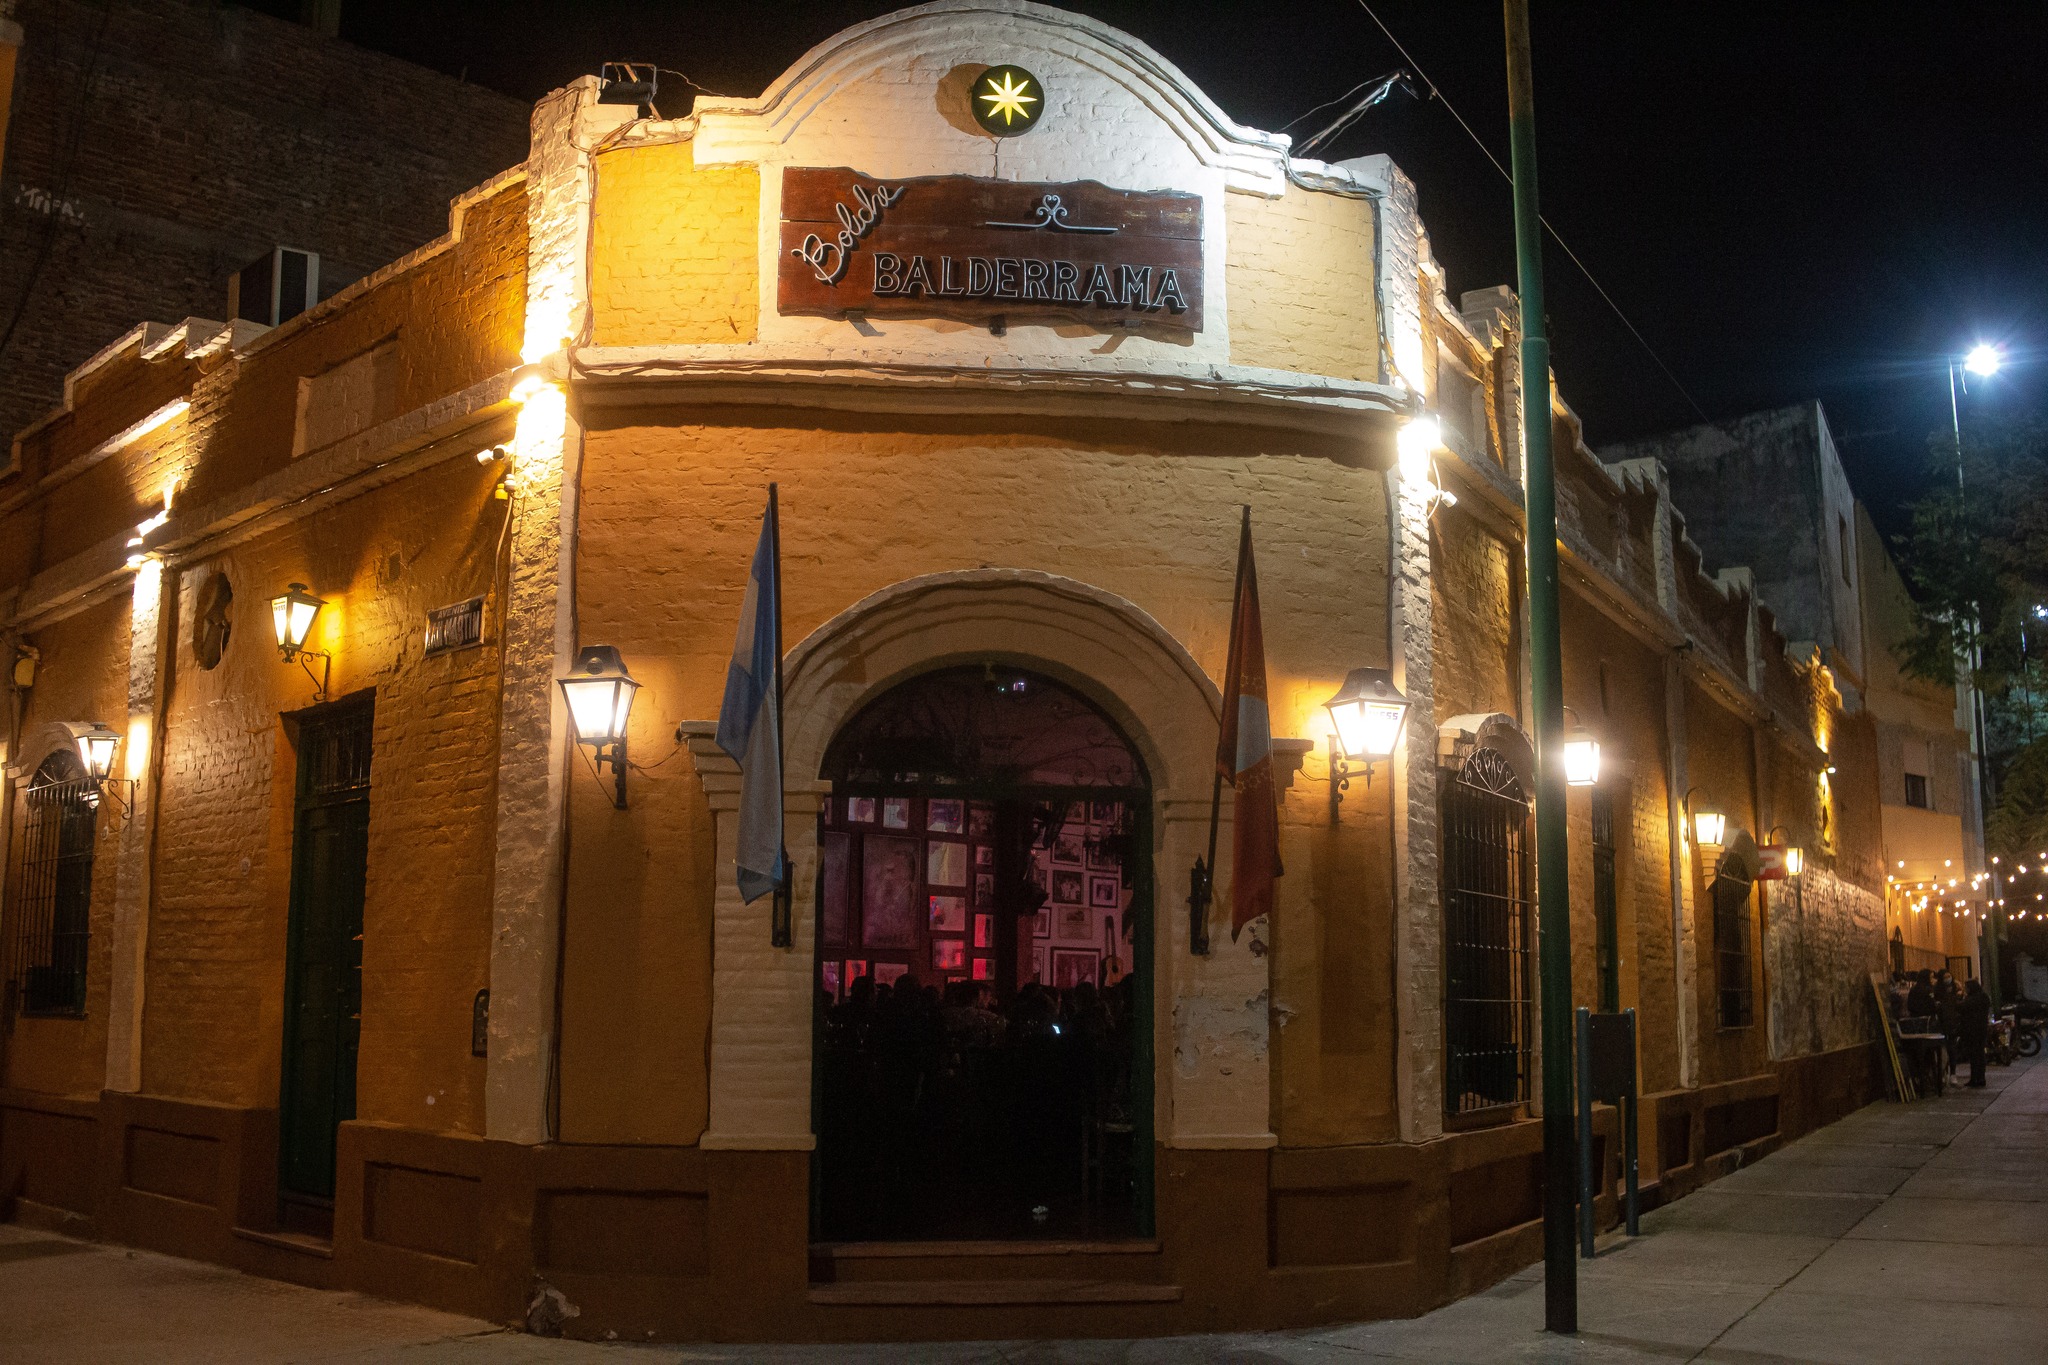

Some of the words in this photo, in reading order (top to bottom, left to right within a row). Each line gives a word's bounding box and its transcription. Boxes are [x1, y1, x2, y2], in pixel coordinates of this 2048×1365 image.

[791, 184, 904, 284] Boliche
[871, 252, 1189, 308] BALDERRAMA
[437, 602, 470, 619] AVENIDA
[444, 611, 480, 644] MARTIN
